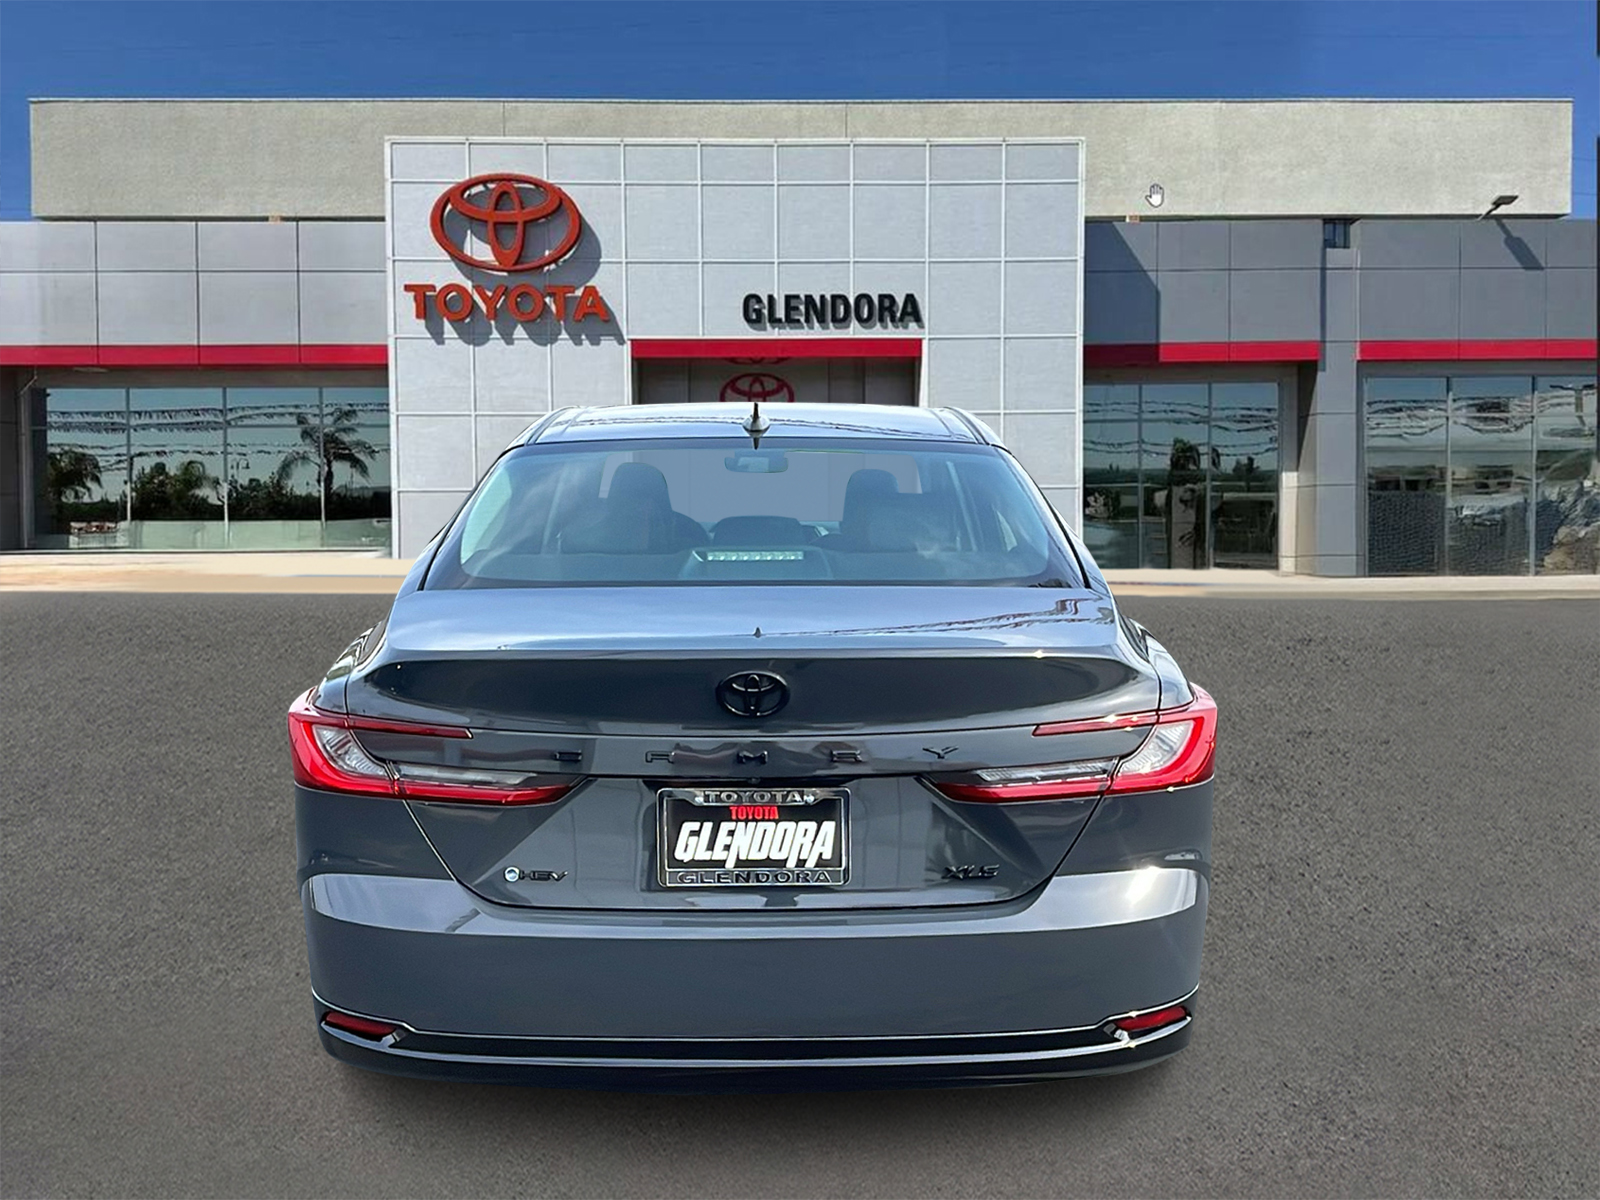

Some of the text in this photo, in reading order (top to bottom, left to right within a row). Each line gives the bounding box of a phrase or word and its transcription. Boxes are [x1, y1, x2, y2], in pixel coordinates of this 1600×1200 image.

[404, 283, 610, 323] TOYOTA
[742, 293, 923, 326] GLENDORA
[704, 790, 802, 803] TOYOTA
[729, 806, 779, 820] TOYOTA
[674, 821, 836, 868] GLENDORA
[676, 870, 832, 884] GLENDORA
[941, 864, 999, 880] XLE
